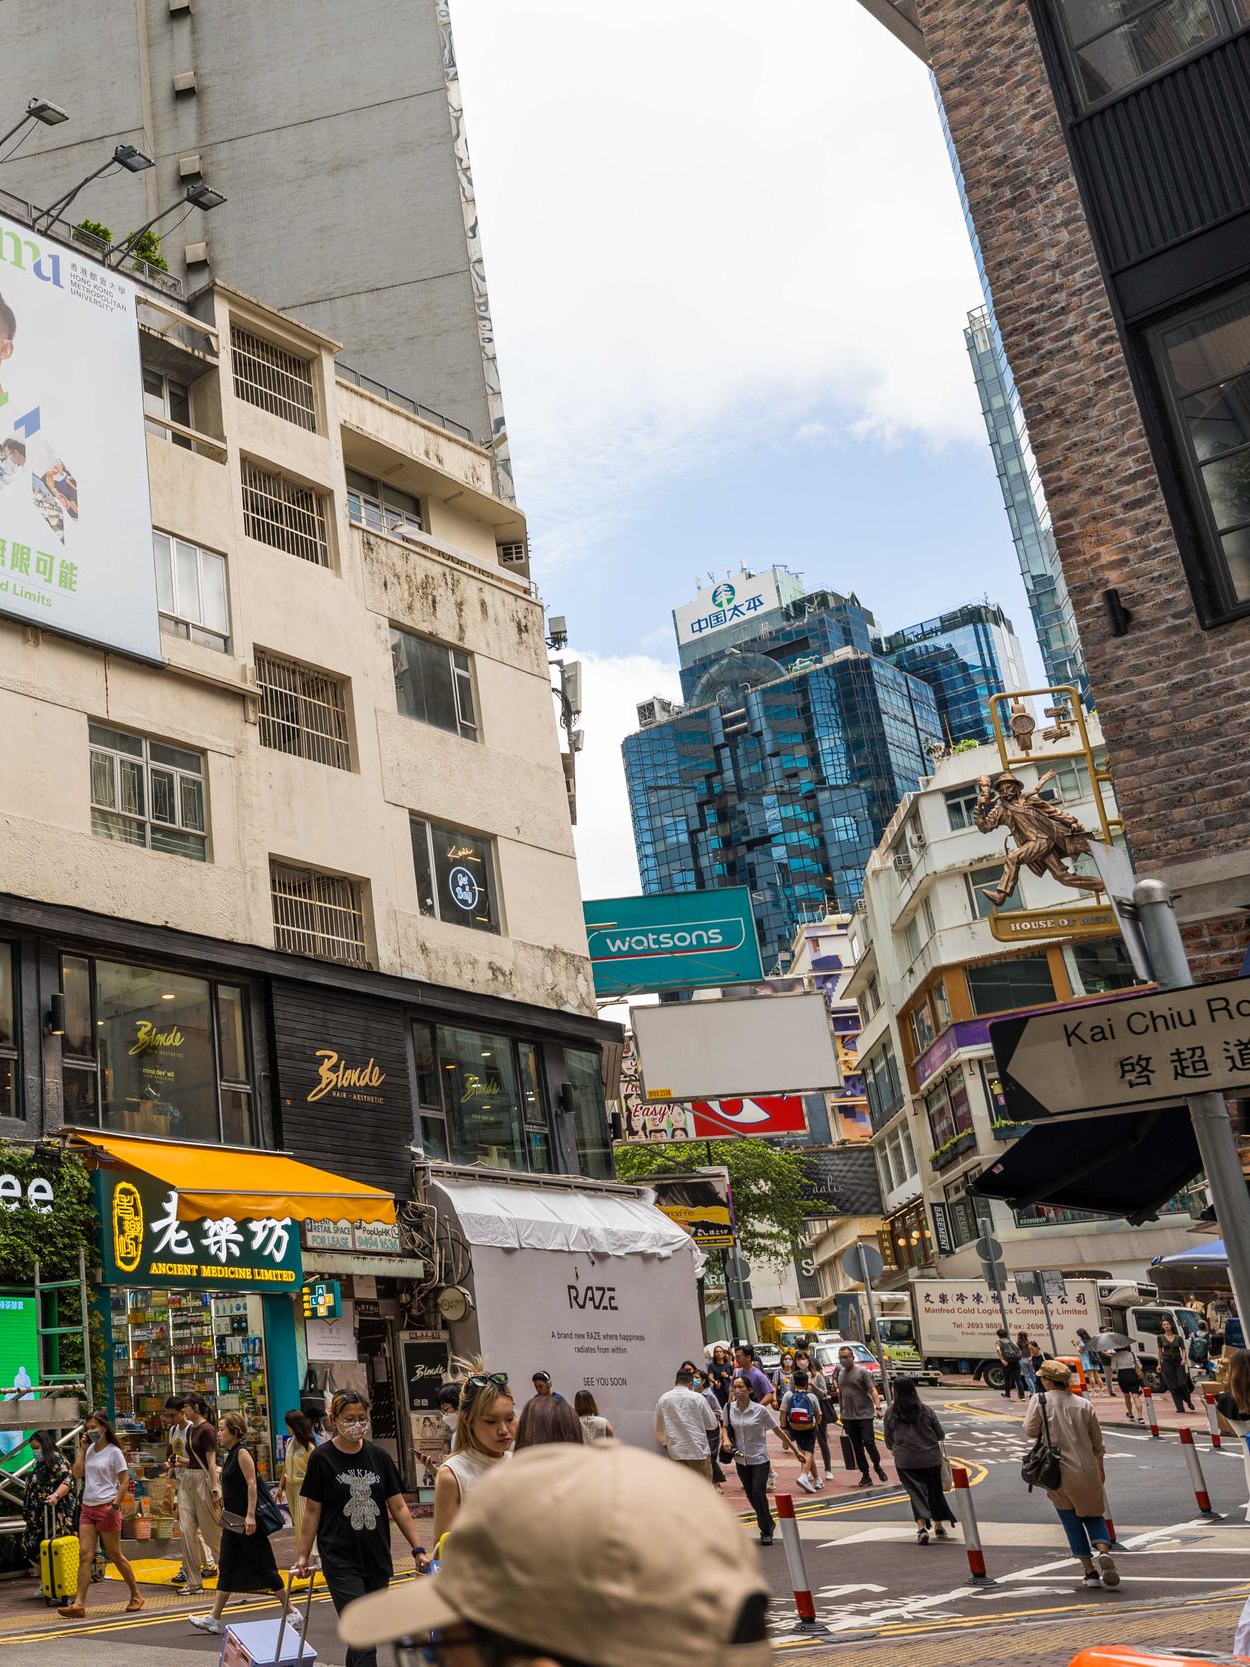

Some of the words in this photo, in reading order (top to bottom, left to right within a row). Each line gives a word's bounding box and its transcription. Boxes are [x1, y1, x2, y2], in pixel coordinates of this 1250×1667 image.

[70, 262, 126, 294] 香港都會大學
[70, 273, 92, 287] HONG
[93, 284, 114, 297] KONG
[70, 280, 127, 311] METROPOLITAN
[70, 289, 115, 313] UNIVERSITY
[13, 584, 52, 607] Limits
[690, 594, 764, 634] 中国太平
[1010, 919, 1055, 932] HOUSE
[606, 928, 723, 953] watsons
[1063, 1018, 1116, 1047] Kai
[1126, 1007, 1197, 1035] Chiu
[128, 1020, 186, 1055] Blonde
[307, 1050, 386, 1102] Blonde
[353, 1094, 384, 1104] AESTHETIC
[632, 1103, 675, 1123] Easy!
[664, 1209, 695, 1217] raffe
[313, 1224, 332, 1234] RETAIL
[333, 1226, 351, 1236] SPACE
[362, 1226, 392, 1238] PopUpHK
[934, 1206, 950, 1251] BASEMENT
[311, 1235, 327, 1246] FOR
[327, 1235, 349, 1248] LEASE
[150, 1262, 198, 1276] ANCIENT
[200, 1265, 252, 1280] MEDICINE
[252, 1268, 296, 1282] LIMITED
[567, 1285, 619, 1310] RAZE
[924, 1307, 956, 1315] Manfred
[957, 1307, 975, 1315] Cold
[977, 1308, 1013, 1316] Logiscs
[1015, 1308, 1054, 1317] Compay
[1056, 1308, 1088, 1316] Limited
[551, 1331, 556, 1339] A
[556, 1330, 573, 1339] brand
[586, 1331, 602, 1340] RAZE
[602, 1332, 619, 1341] where
[619, 1333, 645, 1343] happiness
[574, 1345, 597, 1354] radiates
[597, 1345, 610, 1354] from
[611, 1346, 628, 1354] within
[411, 1364, 447, 1382] Blonde
[583, 1377, 594, 1386] SEE
[596, 1377, 610, 1387] YOU
[610, 1377, 628, 1387] SOON
